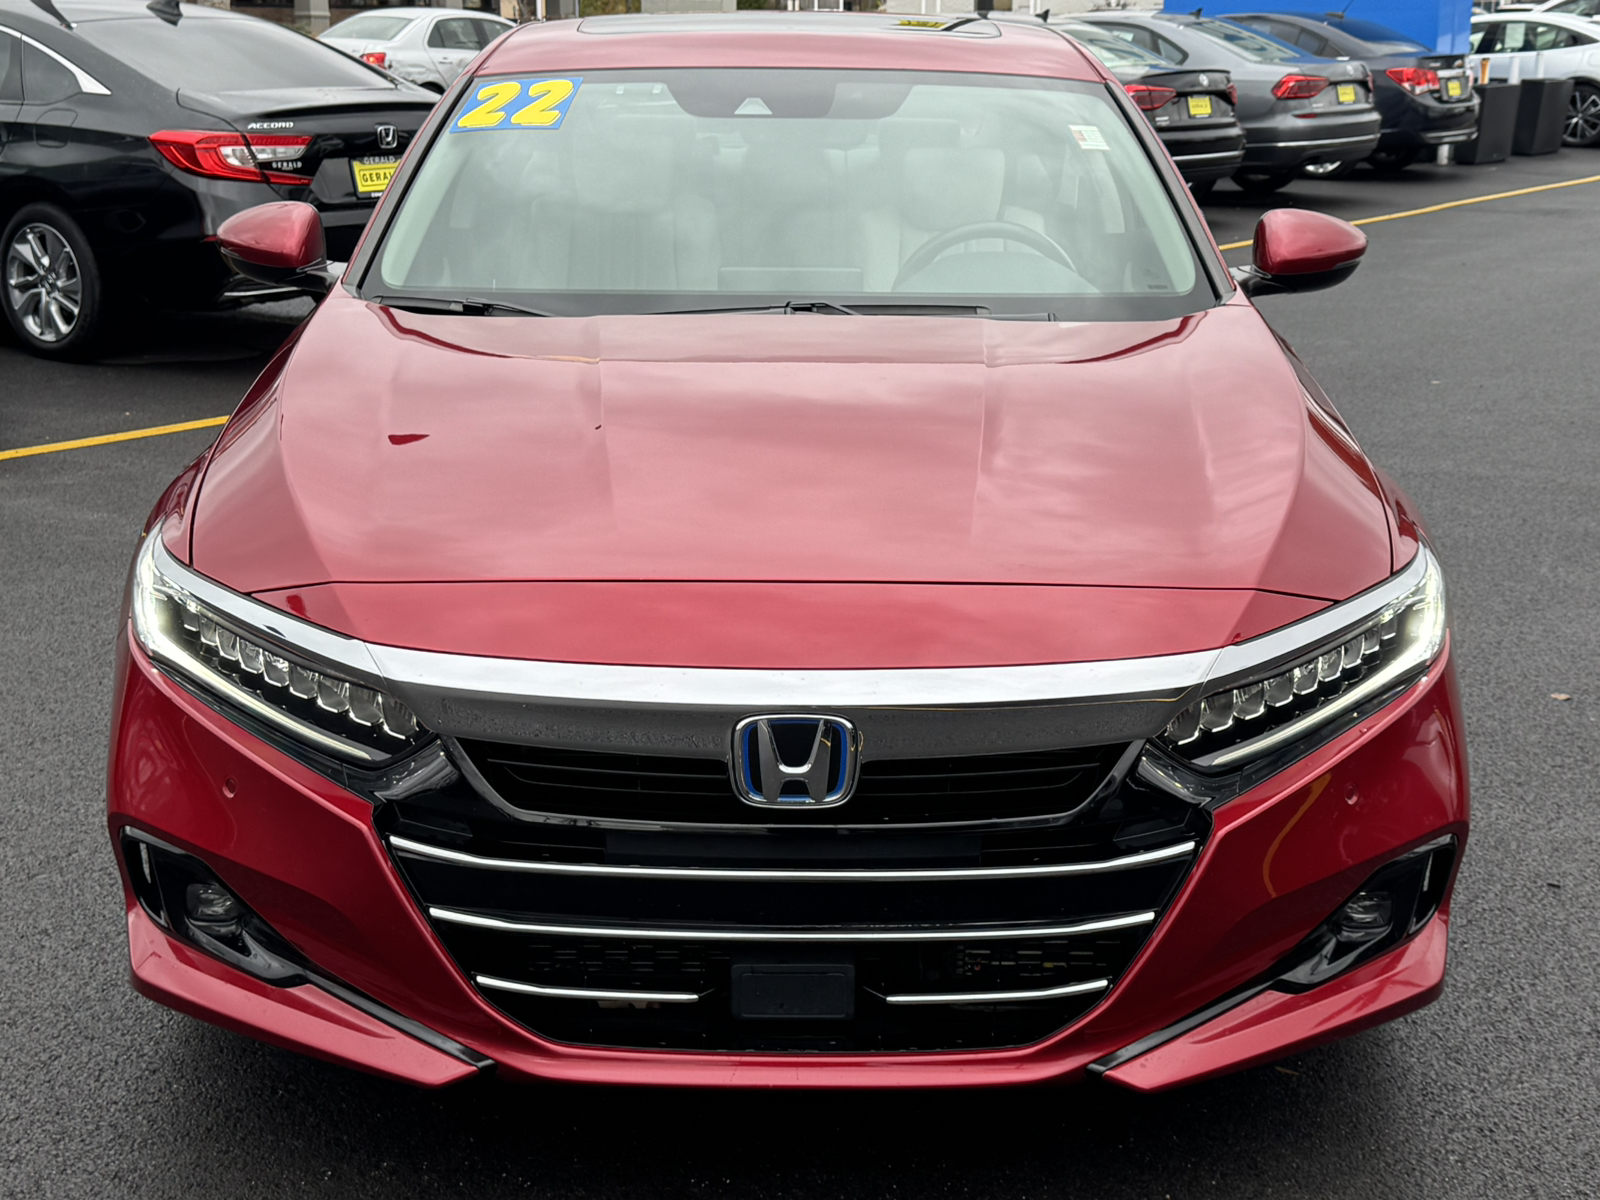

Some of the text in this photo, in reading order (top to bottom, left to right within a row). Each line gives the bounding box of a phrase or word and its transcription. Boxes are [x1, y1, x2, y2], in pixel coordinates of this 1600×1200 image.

[457, 80, 574, 128] 22
[247, 121, 294, 130] ACCORD
[363, 155, 396, 164] GERALD
